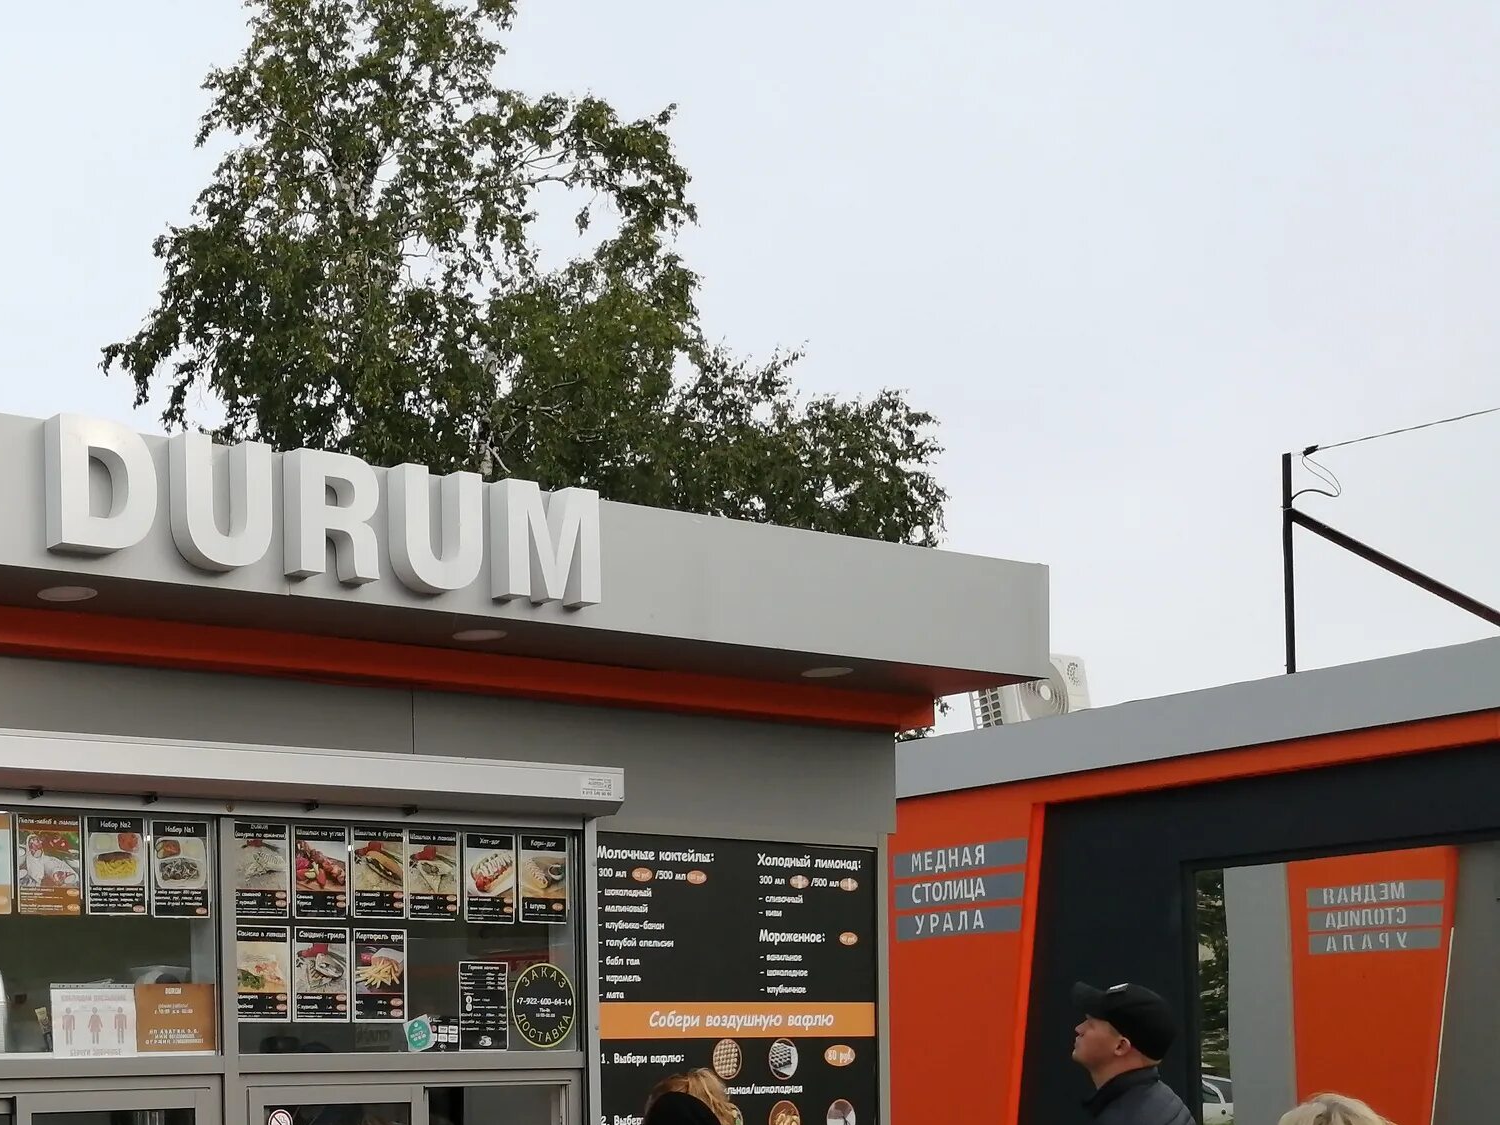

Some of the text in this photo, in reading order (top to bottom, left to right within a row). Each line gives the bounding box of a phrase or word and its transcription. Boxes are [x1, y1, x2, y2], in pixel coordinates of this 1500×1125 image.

[45, 413, 600, 609] DURUM
[101, 821, 118, 829] Набор
[165, 826, 182, 834] Набор
[597, 845, 655, 861] Молочные
[911, 844, 985, 873] МЕДНАЯ
[757, 853, 861, 871] Холодный лимонад:
[598, 868, 612, 878] 300
[759, 875, 772, 884] 300
[912, 877, 985, 904] СТОЛИЦА
[915, 910, 984, 935] УРАЛА
[606, 938, 636, 949] голубой
[759, 929, 826, 945] Мороженное:
[606, 956, 624, 965] бабл
[522, 967, 566, 988] ЗАКАЗ
[606, 975, 641, 984] карамель
[517, 1013, 571, 1043] ДОСТАВКА
[650, 1010, 834, 1033] Собери воздушную вафлю
[614, 1053, 648, 1068] Выбери
[650, 1053, 684, 1066] вафлю:
